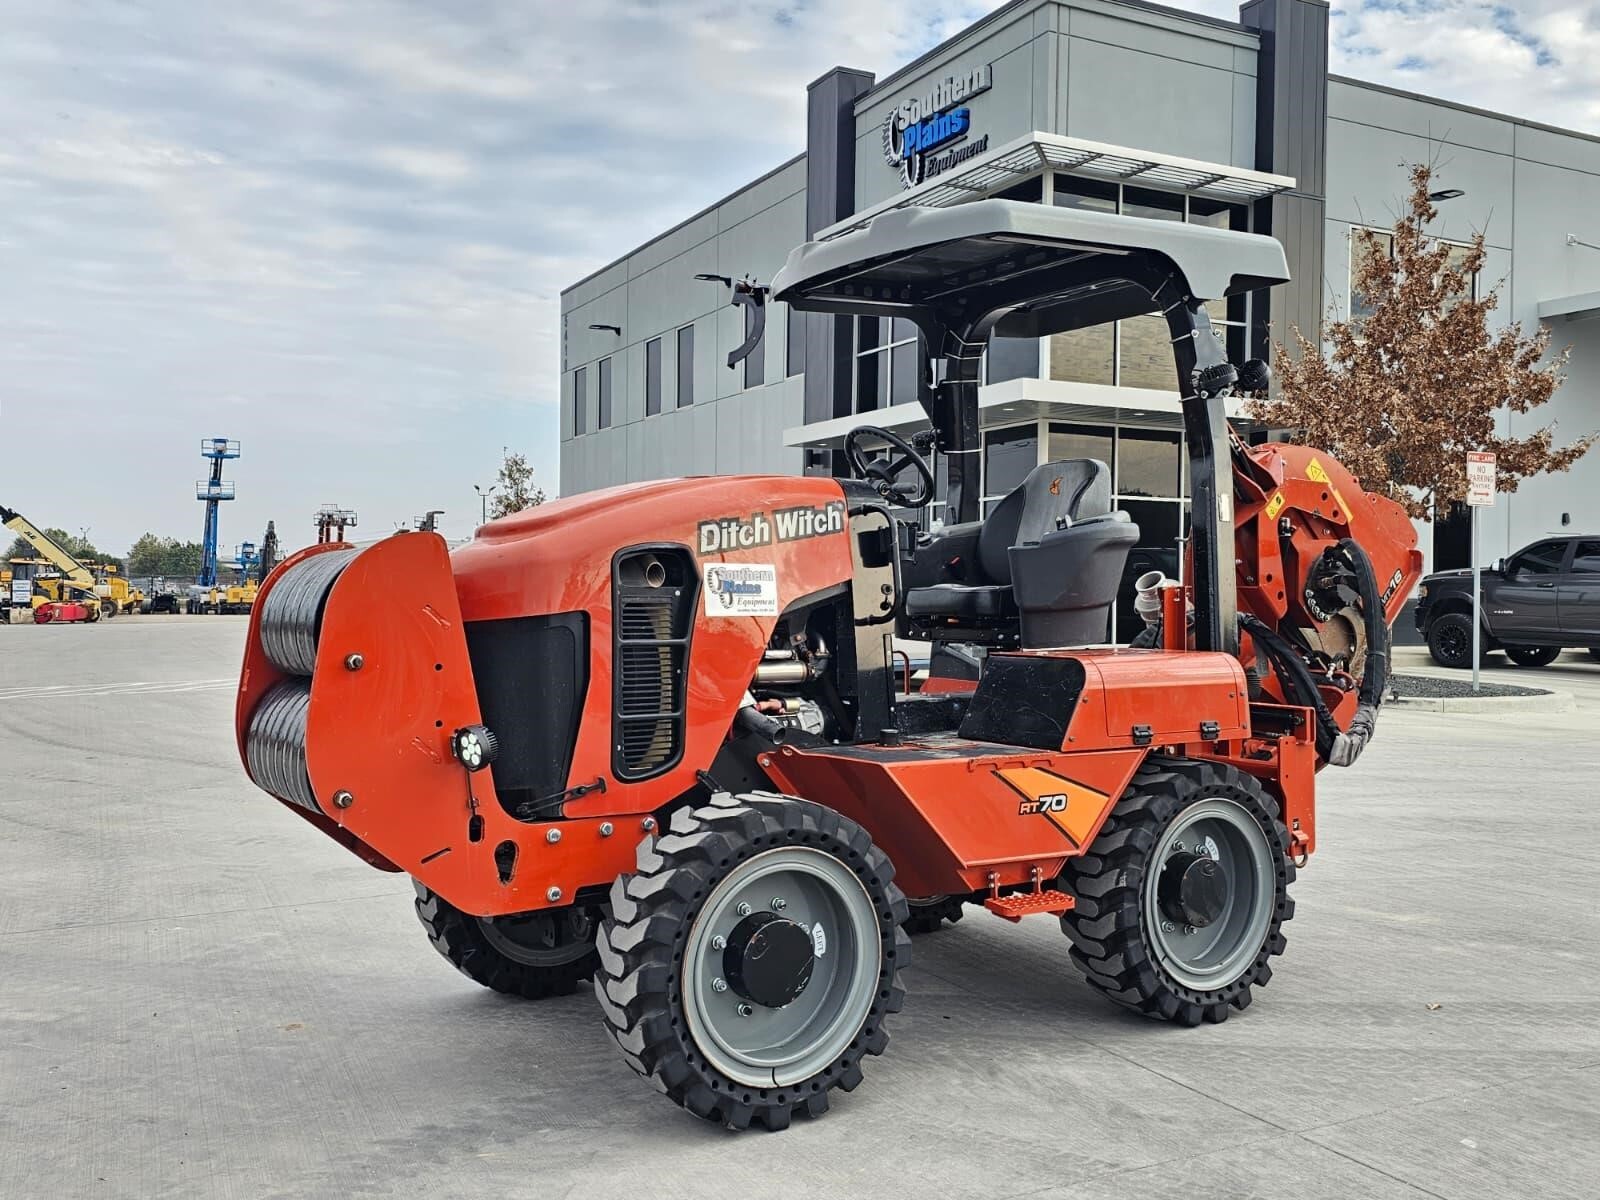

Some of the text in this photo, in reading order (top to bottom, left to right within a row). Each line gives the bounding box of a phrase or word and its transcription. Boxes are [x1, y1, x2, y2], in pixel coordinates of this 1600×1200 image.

[898, 64, 992, 130] Southern
[903, 107, 970, 159] Plains
[924, 133, 989, 178] Equipment
[1469, 474, 1494, 483] PARKING
[700, 504, 842, 553] Ditch Witch
[718, 567, 774, 581] Southern
[723, 580, 761, 594] Plains
[737, 597, 775, 607] Equipment
[1019, 794, 1067, 815] RT70
